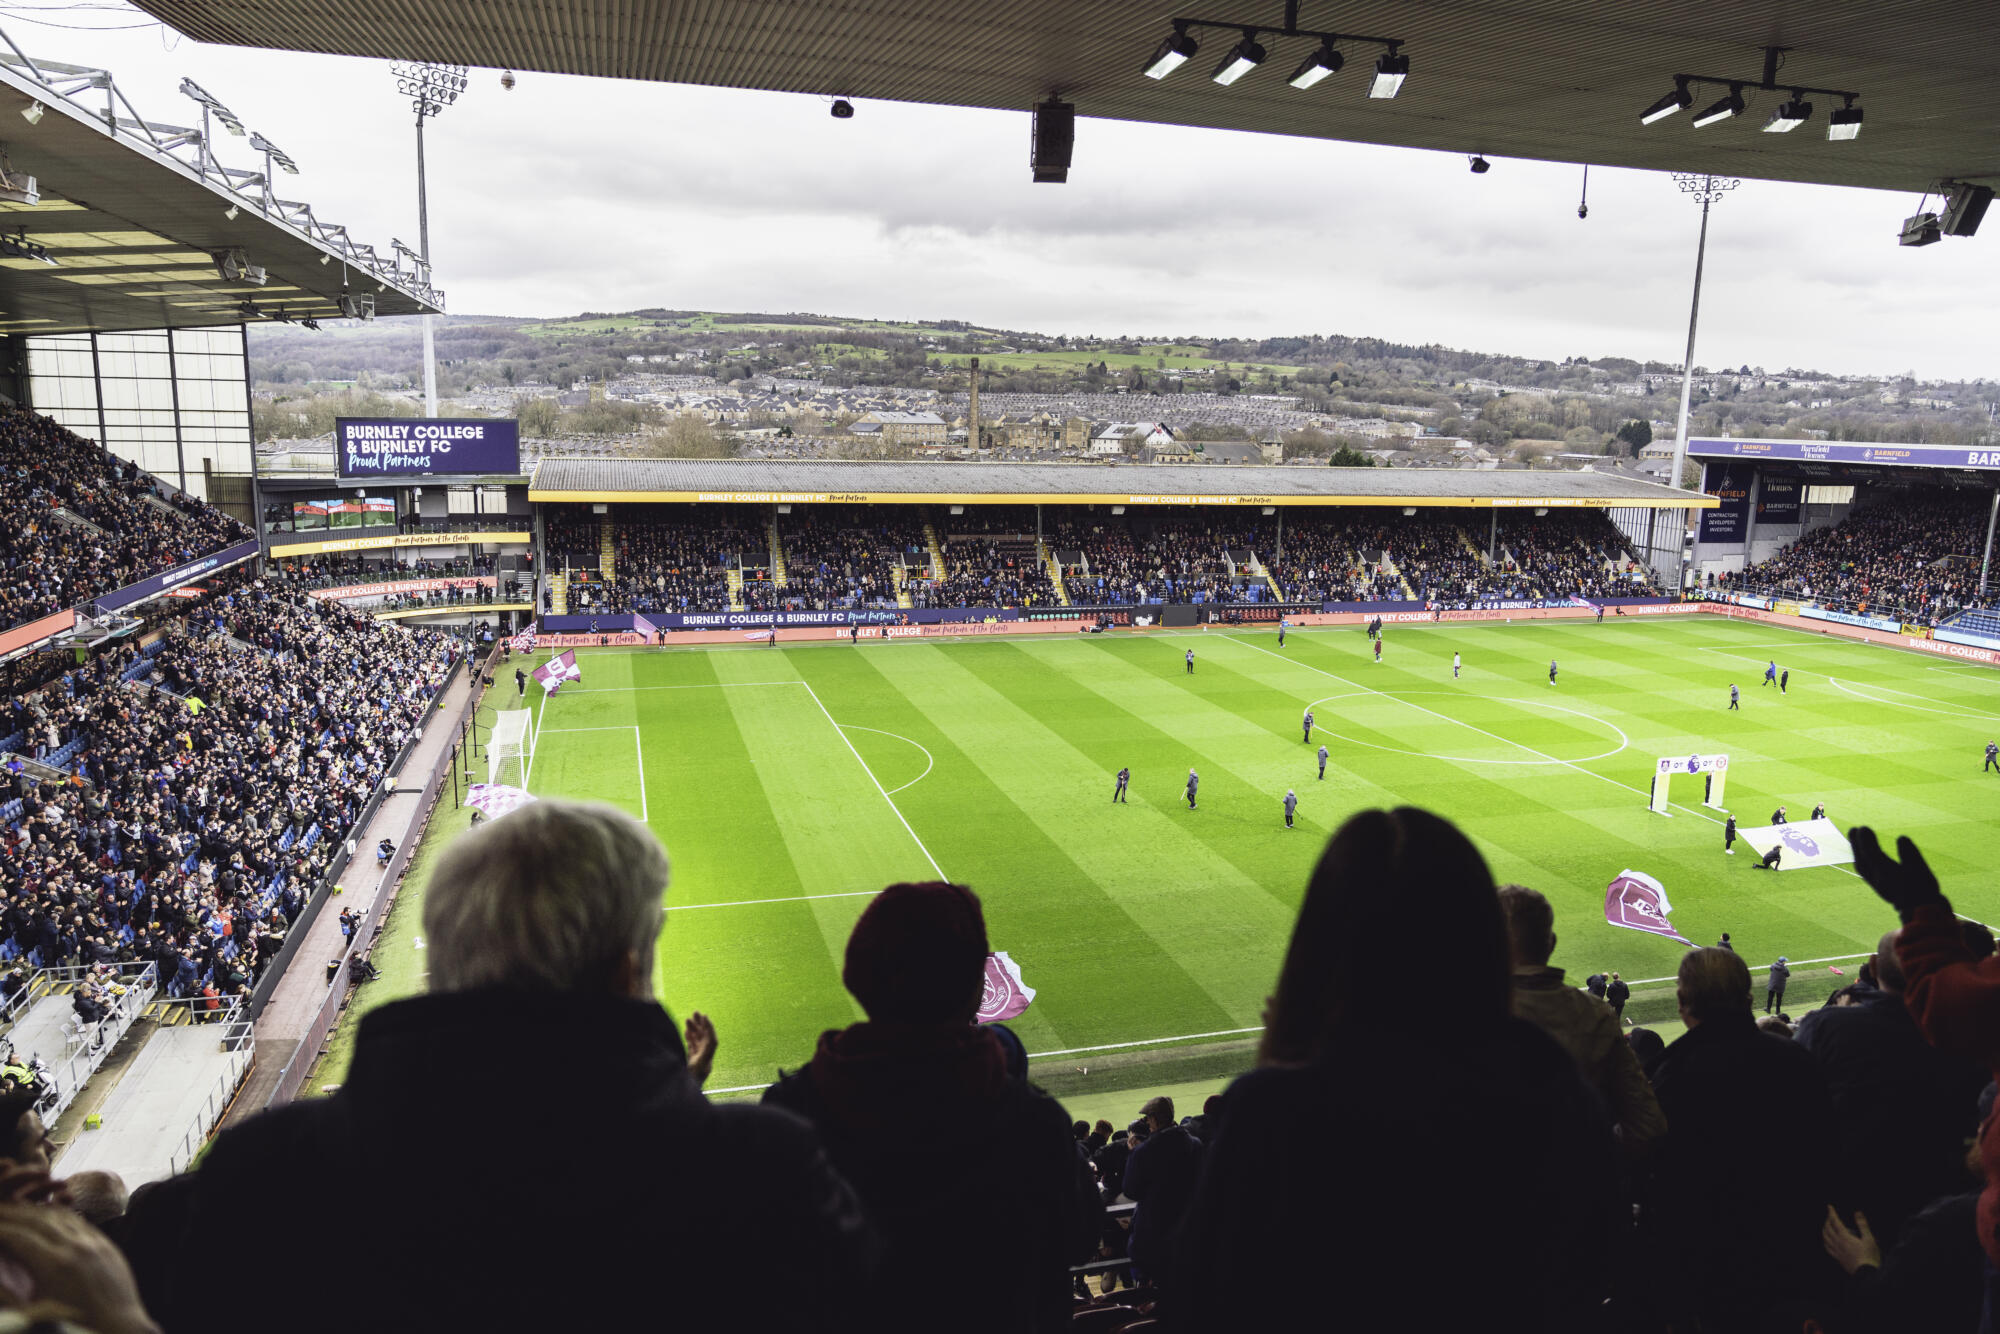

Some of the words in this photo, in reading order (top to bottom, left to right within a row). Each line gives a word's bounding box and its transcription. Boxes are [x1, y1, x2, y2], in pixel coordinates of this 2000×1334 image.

[346, 426, 409, 439] BURNLEY
[414, 426, 484, 440] COLLEGE
[346, 440, 357, 454] &
[361, 440, 425, 454] BURNLEY
[430, 440, 452, 453] FC
[348, 452, 381, 472] Proud
[384, 452, 431, 471] Partners
[698, 493, 732, 502] BURNLEY
[322, 540, 357, 552] BURNLEY
[358, 538, 393, 548] COLLEGE
[320, 589, 350, 599] BURNLEY
[352, 585, 386, 595] COLLEGE
[395, 582, 430, 591] BURNLEY
[431, 580, 442, 589] FC
[1501, 601, 1532, 609] BURNLEY
[1639, 605, 1668, 614] BURNLEY
[1669, 604, 1698, 612] COLLEGE
[683, 616, 727, 625] BURNLEY
[730, 614, 774, 624] COLLEGE
[776, 614, 784, 623] &
[787, 613, 829, 623] BURNLEY
[832, 613, 845, 622] FC
[1398, 612, 1432, 621] COLLEGE
[1909, 638, 1948, 653] BURNLEY
[1950, 646, 1992, 660] COLLEGE
